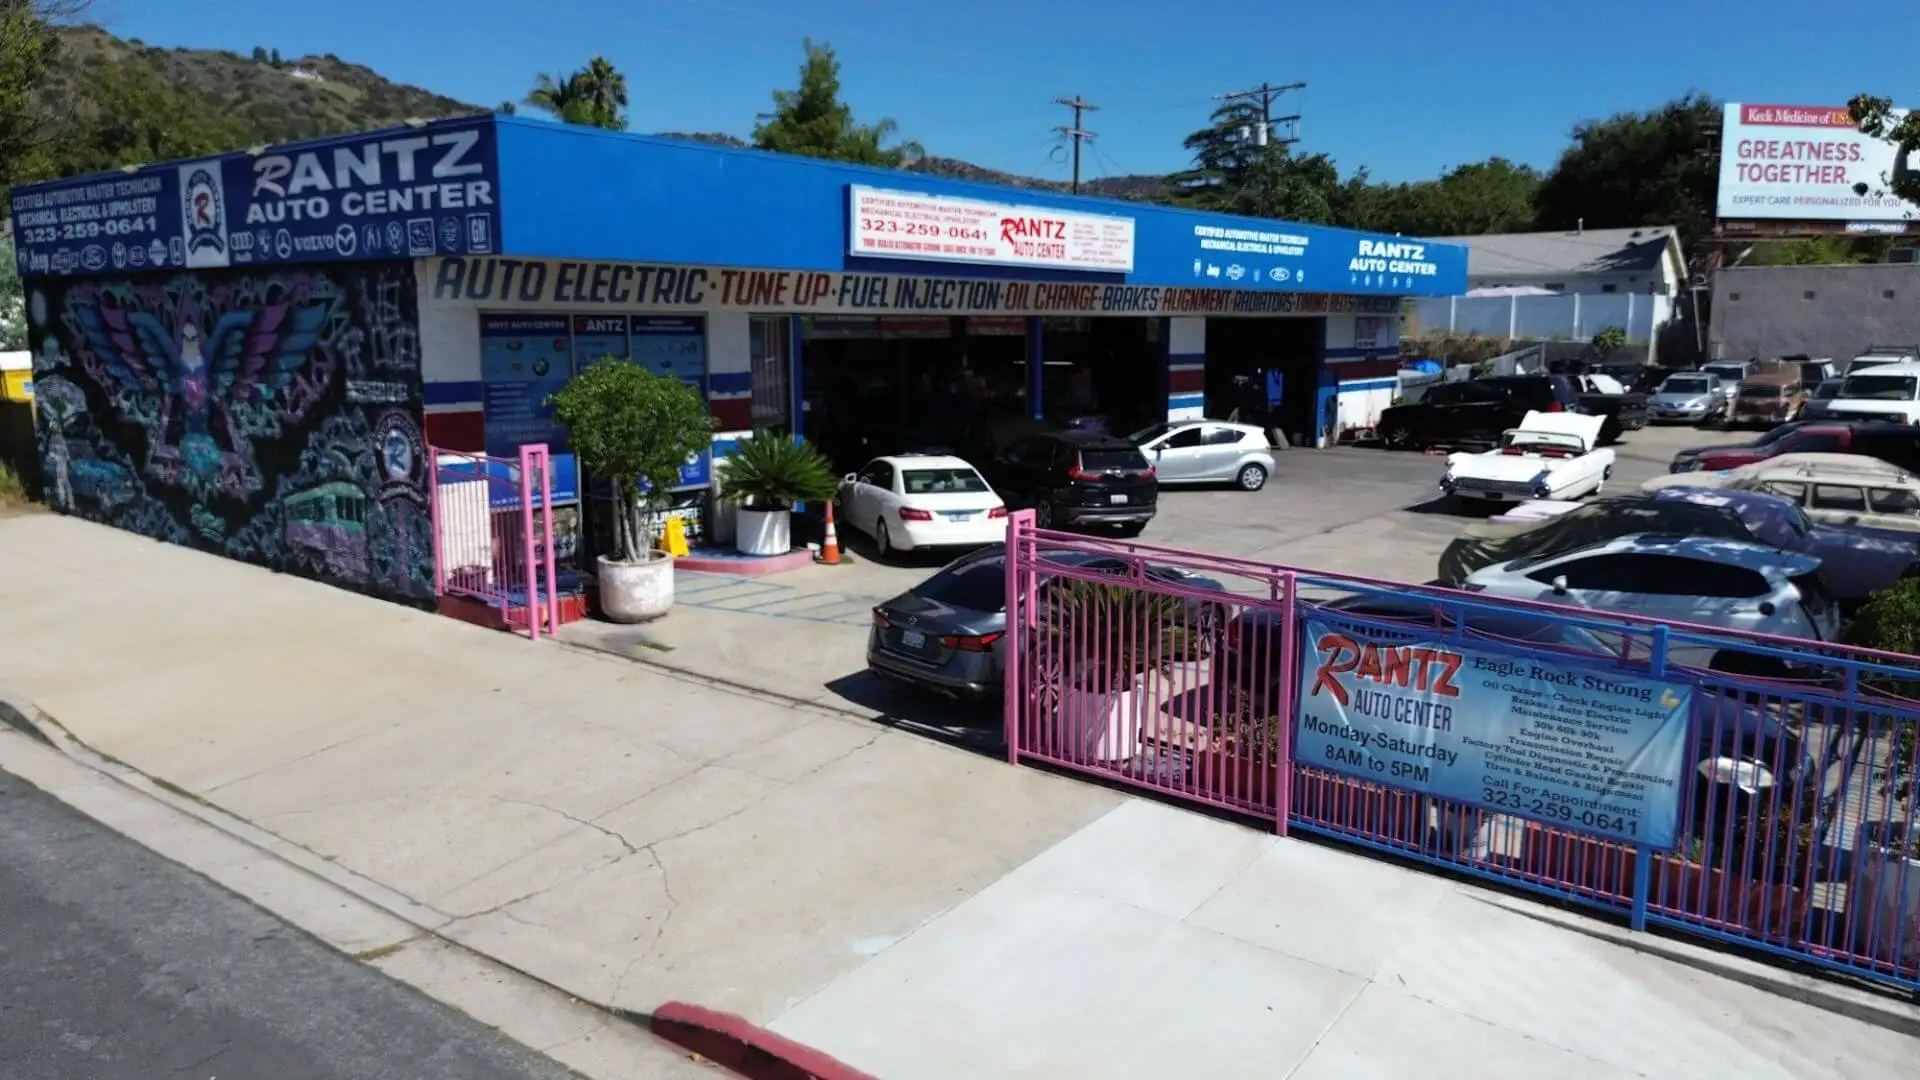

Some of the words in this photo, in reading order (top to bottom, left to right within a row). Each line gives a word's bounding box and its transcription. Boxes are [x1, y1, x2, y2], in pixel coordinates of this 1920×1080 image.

[1747, 108, 1773, 122] Keck
[1775, 108, 1818, 124] Medicine
[1820, 111, 1831, 124] of
[253, 130, 484, 198] RANTZ
[1737, 139, 1865, 163] GREATNESS.
[1736, 163, 1851, 185] TOGETHER.
[246, 196, 330, 224] AUTO
[341, 180, 494, 216] CENTER
[1732, 195, 1766, 205] EXPERT
[1767, 196, 1791, 206] CARE
[1793, 196, 1861, 207] PERSONALIZED
[1863, 198, 1881, 208] FOR
[861, 217, 988, 241] 323-259-0641
[1000, 217, 1066, 245] RANTZ
[1014, 241, 1034, 257] AUTO
[1036, 242, 1065, 260] CENTER
[1359, 239, 1425, 260] RANTZ
[1349, 258, 1387, 272] AUTO
[1389, 260, 1437, 276] CENTER
[435, 256, 547, 301] AUTO
[554, 262, 708, 304] ELECTRIC
[720, 270, 788, 306] TUNE
[794, 272, 831, 306] UP
[838, 275, 890, 308] FUEL
[894, 276, 1001, 310] INJECTION
[1003, 282, 1031, 310] OIL
[1033, 284, 1100, 311] CHANGE
[1101, 285, 1160, 312] BRAKES
[1162, 287, 1233, 312] ALIGNMENT
[1310, 632, 1465, 707] RANTZ
[1474, 656, 1526, 677] Eagle
[1530, 665, 1577, 687] Rock
[1582, 675, 1653, 703] Strong
[1353, 688, 1391, 720] AUTO
[1394, 696, 1453, 732] CENTER
[1482, 679, 1498, 691] Oil
[1502, 683, 1543, 698] Change
[1552, 692, 1588, 707] Check
[1591, 699, 1632, 715] Engine
[1635, 707, 1668, 720] Light
[1511, 695, 1548, 710] Brakes
[1557, 704, 1582, 716] Auto
[1585, 709, 1632, 725] Electric
[1511, 706, 1582, 726] Maintenance
[1585, 719, 1629, 735] Service
[1304, 713, 1458, 767] Monday-Saturday
[1462, 736, 1502, 754] Factory
[1503, 745, 1526, 757] Tool
[1528, 750, 1587, 769] Diagnostic
[1591, 762, 1599, 772] &
[1508, 736, 1582, 758] Transmission
[1585, 751, 1625, 766] Repair
[1520, 728, 1559, 743] Engine
[1561, 736, 1614, 753] Overhaul
[1325, 744, 1362, 767] 8AM
[1367, 755, 1385, 773] to
[1391, 760, 1429, 783] 5PM
[1484, 752, 1532, 768] Cylinder
[1534, 762, 1561, 775] Head
[1564, 767, 1604, 783] Gasket
[1482, 775, 1508, 790] Call
[1513, 781, 1537, 795] For
[1541, 788, 1642, 818] Appointment:
[1484, 761, 1510, 773] Tires
[1513, 766, 1521, 775] &
[1525, 770, 1569, 785] Balance
[1571, 779, 1580, 788] &
[1584, 782, 1644, 801] Alignment
[1482, 787, 1637, 836] 323-259-0641
